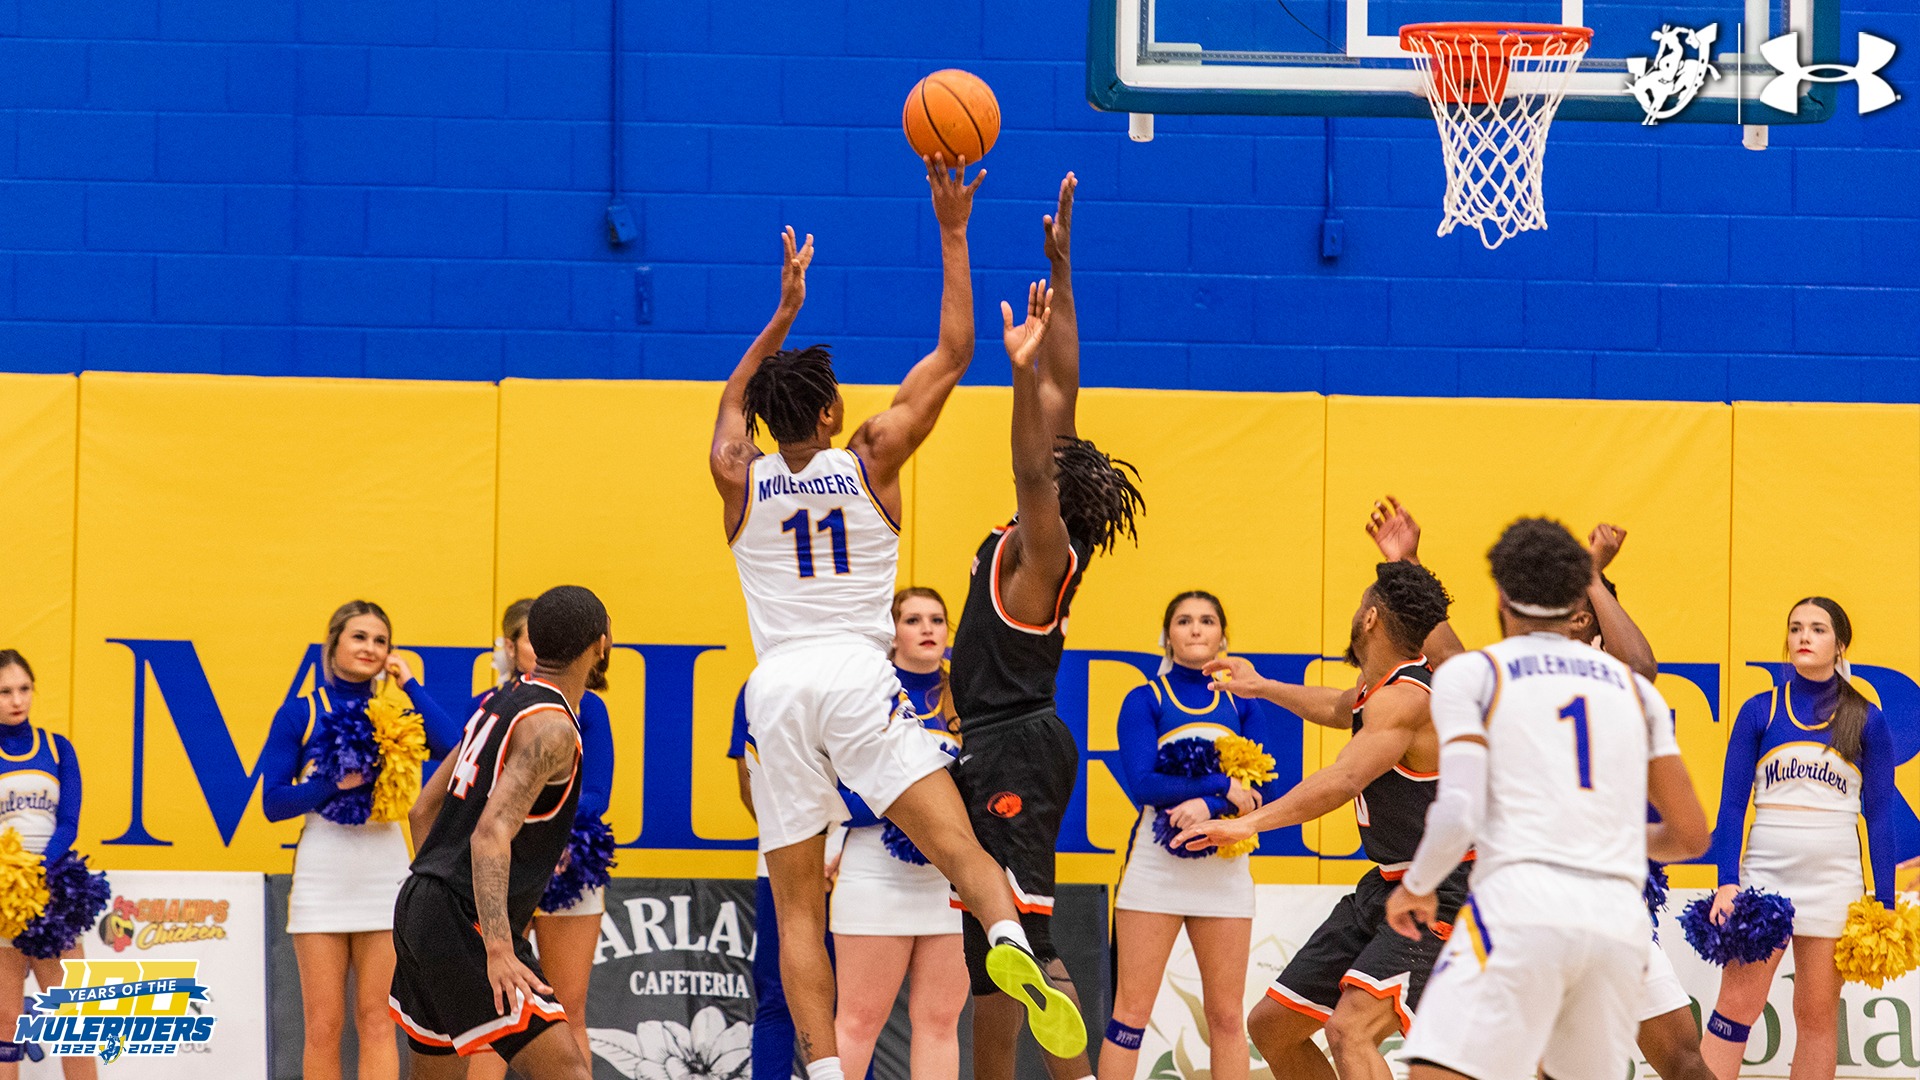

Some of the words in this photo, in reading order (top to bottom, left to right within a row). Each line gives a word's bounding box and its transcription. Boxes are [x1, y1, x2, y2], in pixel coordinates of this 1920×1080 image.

[759, 474, 859, 502] MULERIDERS
[780, 506, 852, 579] 11
[1507, 654, 1627, 691] MULERIDERS
[447, 707, 500, 800] 14
[1557, 694, 1595, 791] 1
[1765, 758, 1848, 795] Muleriders
[134, 898, 229, 923] CHAMPS
[136, 921, 227, 951] Chicken
[528, 895, 758, 965] ARLA
[629, 970, 751, 999] CAFETERIA
